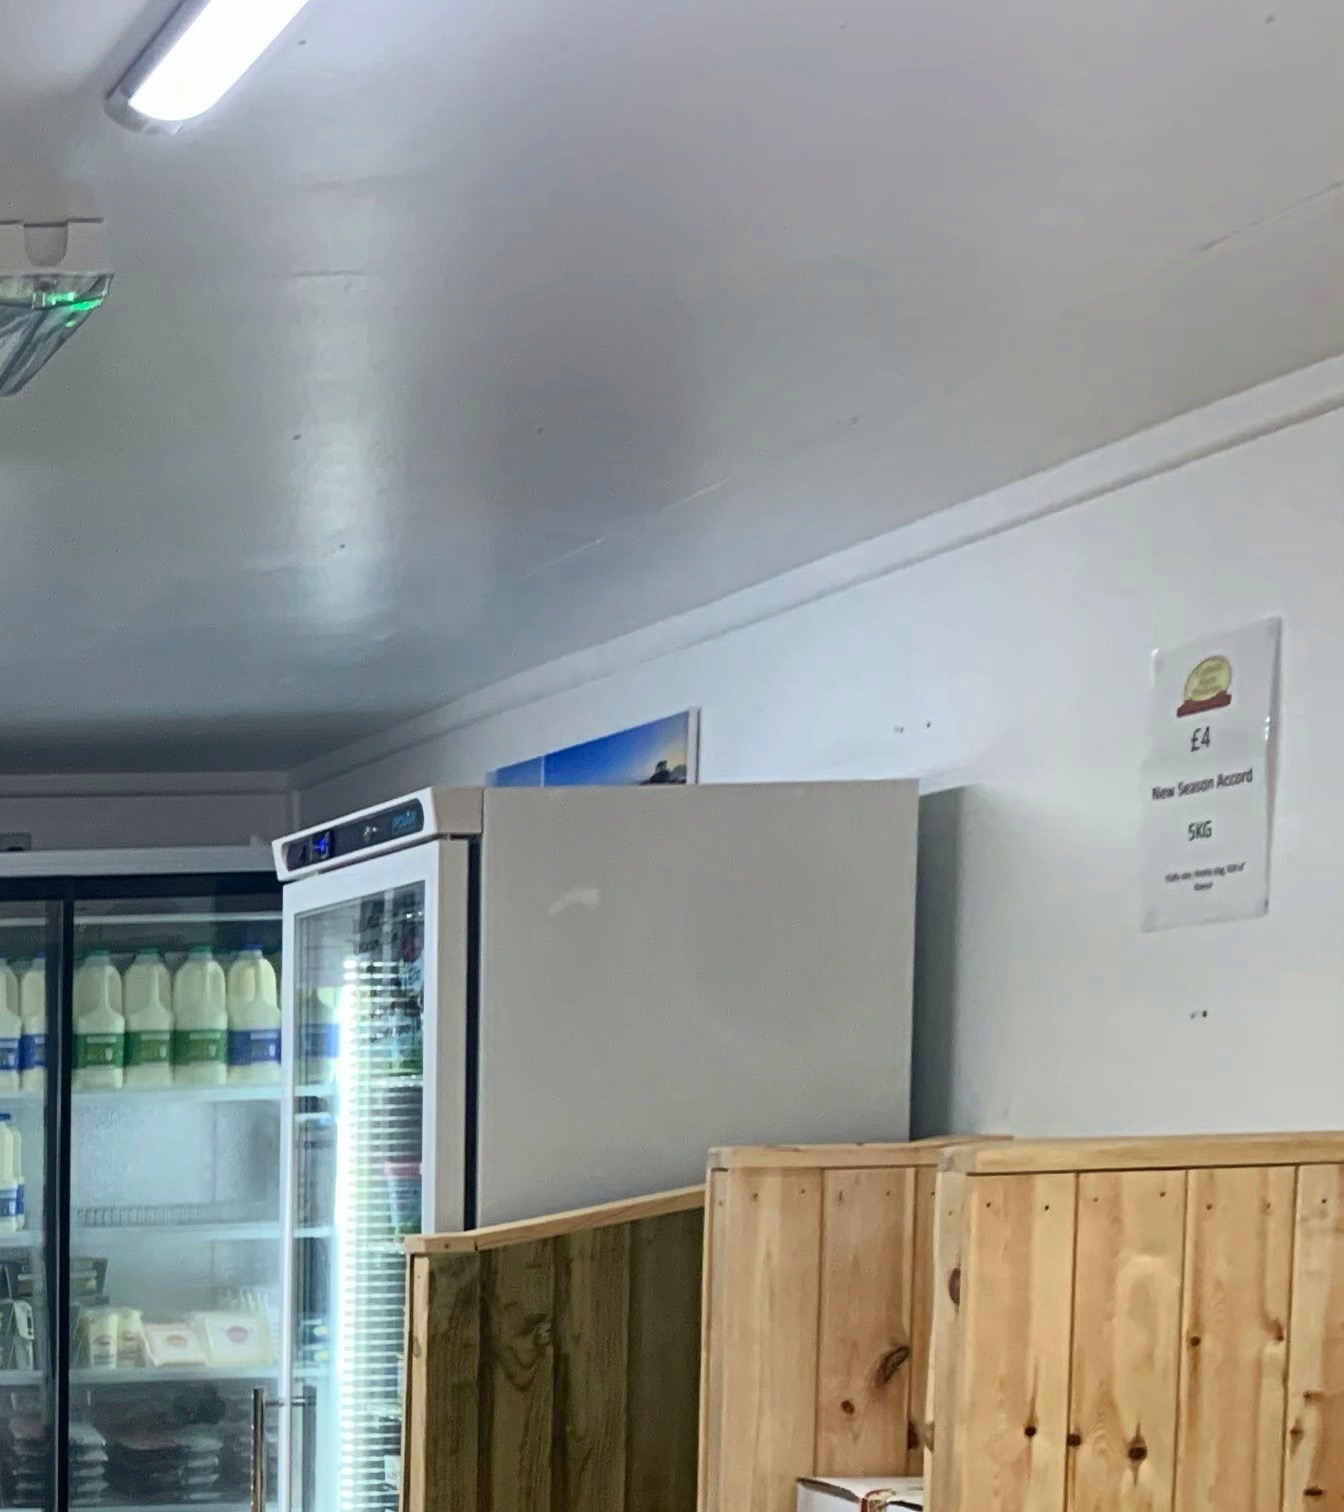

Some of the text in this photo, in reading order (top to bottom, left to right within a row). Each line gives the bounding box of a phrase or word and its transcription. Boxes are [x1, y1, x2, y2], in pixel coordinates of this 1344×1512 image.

[1190, 726, 1211, 752] £4
[1177, 777, 1214, 797] Season
[1216, 768, 1253, 788] Accord
[1188, 820, 1212, 841] 5KG
